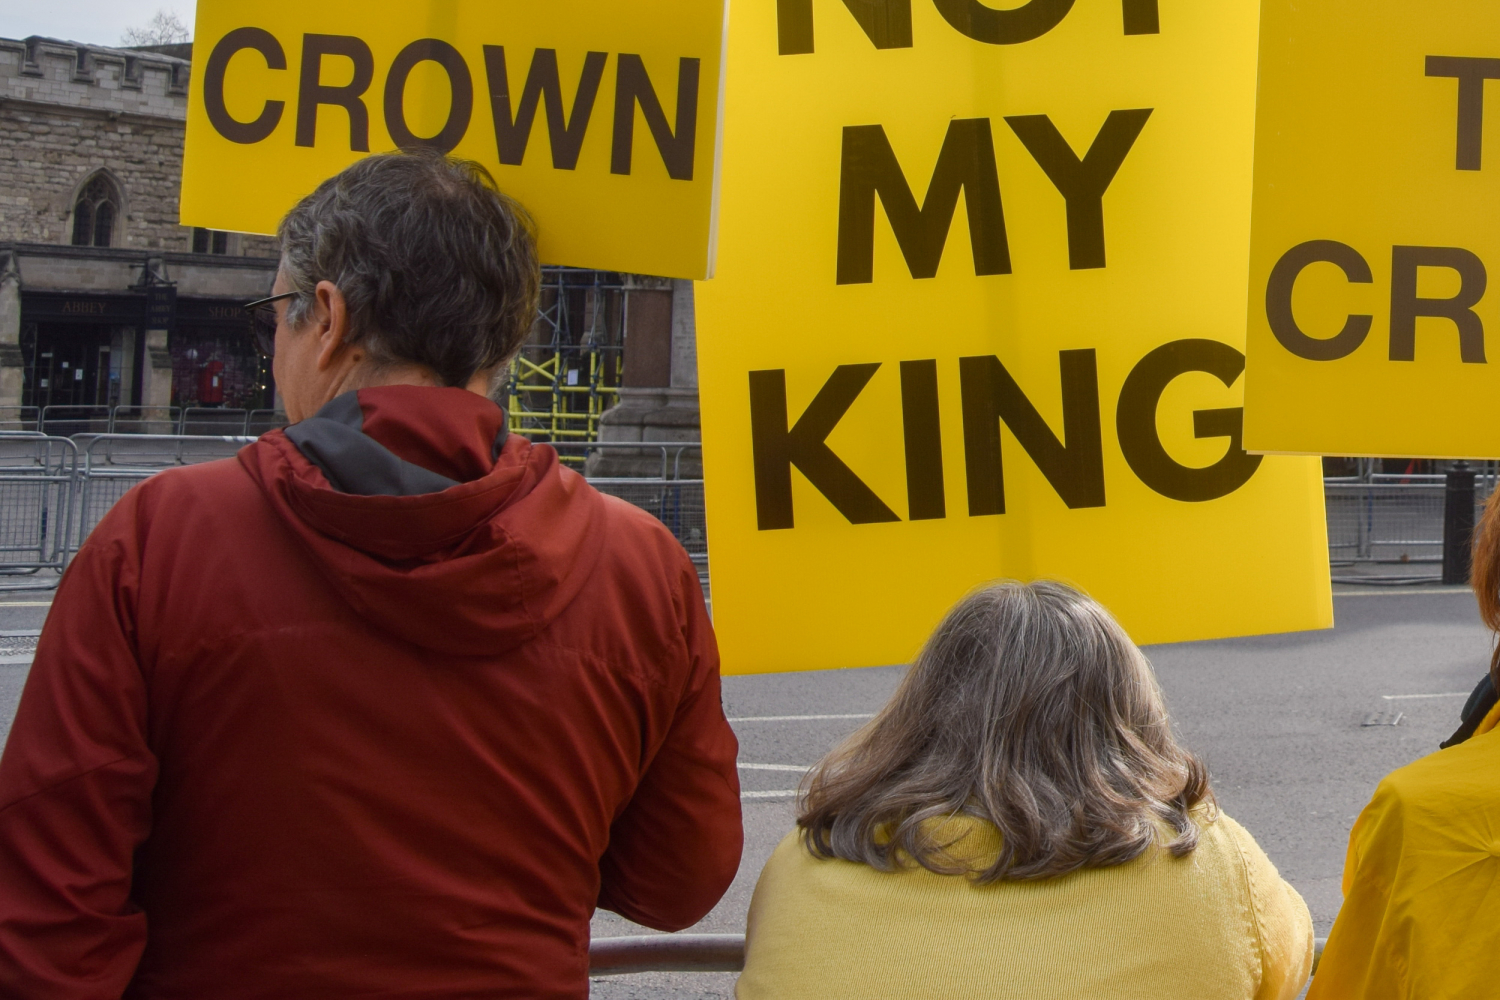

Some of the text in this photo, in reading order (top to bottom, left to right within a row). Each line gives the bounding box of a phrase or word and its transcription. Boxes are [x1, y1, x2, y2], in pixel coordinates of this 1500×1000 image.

[203, 26, 701, 182] CROWN
[836, 108, 1154, 286] MY
[62, 301, 241, 318] ABBEY SHOP
[749, 338, 1264, 531] KING
